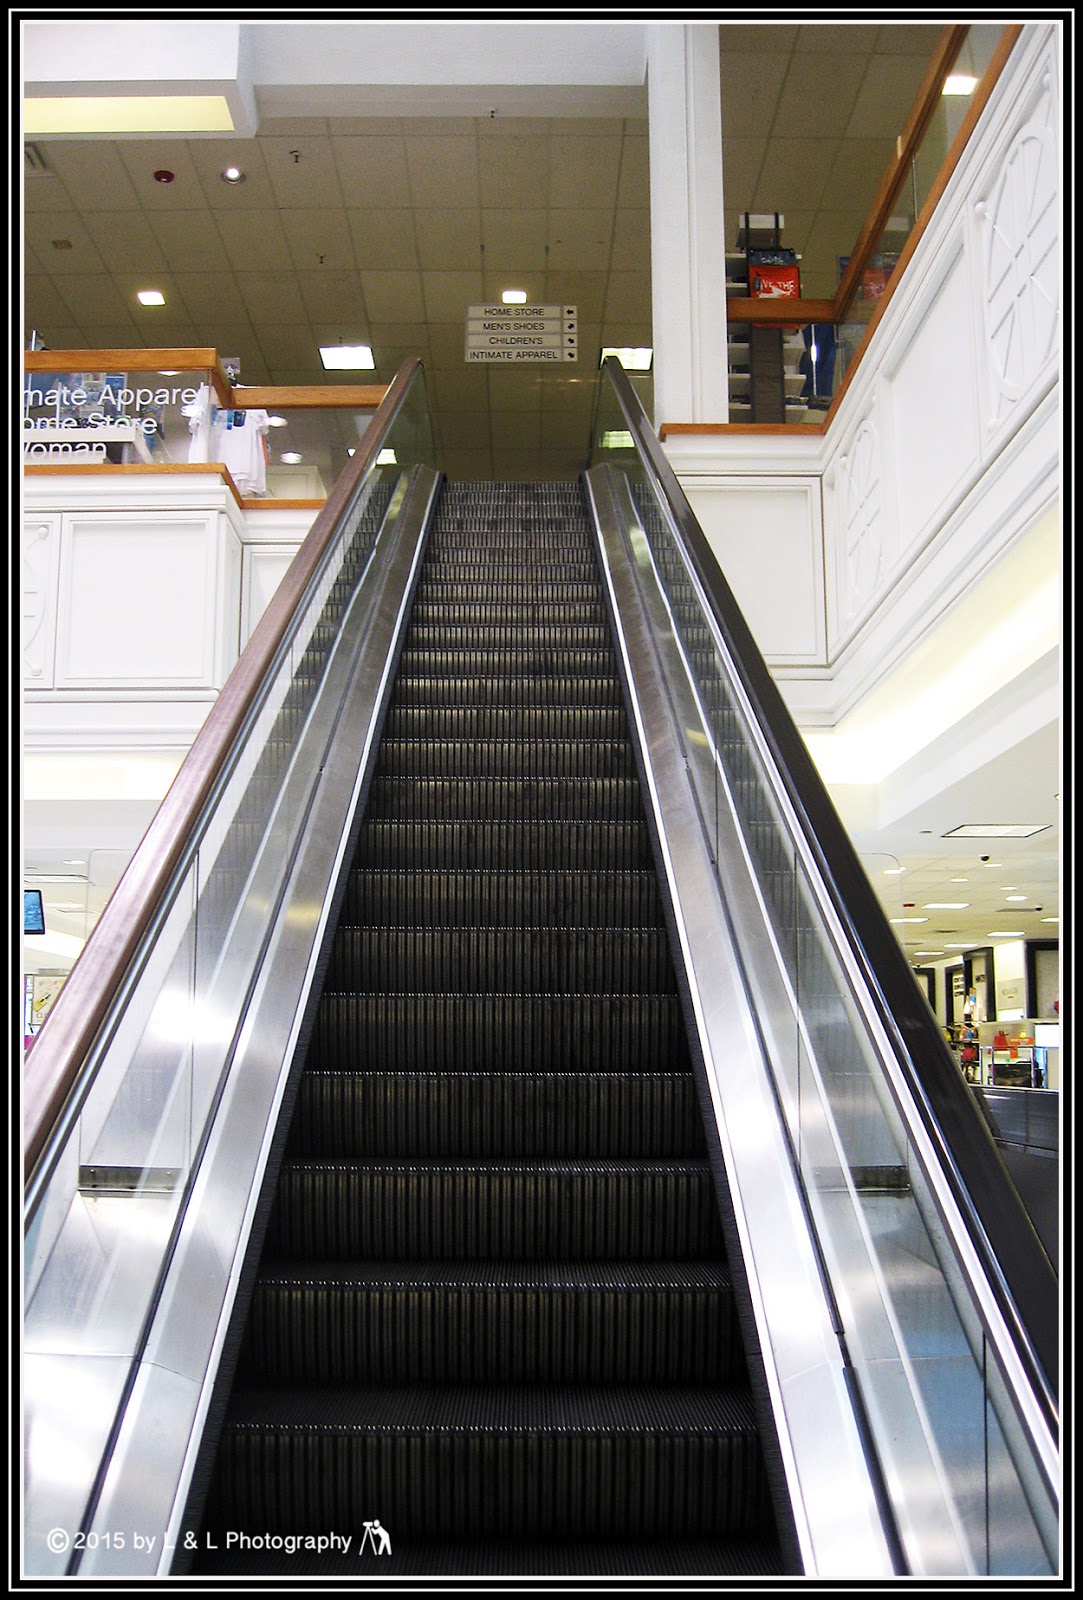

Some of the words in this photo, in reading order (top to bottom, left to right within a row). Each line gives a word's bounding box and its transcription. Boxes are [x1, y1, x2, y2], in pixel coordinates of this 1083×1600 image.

[484, 308, 512, 316] HOME
[514, 308, 545, 316] STORE
[483, 322, 511, 331] MEN'S
[513, 322, 545, 331] SHOES
[488, 336, 543, 345] CHILDREN'S
[469, 351, 513, 359] INTIMATE
[515, 351, 558, 359] APPAREL
[88, 412, 158, 435] Store
